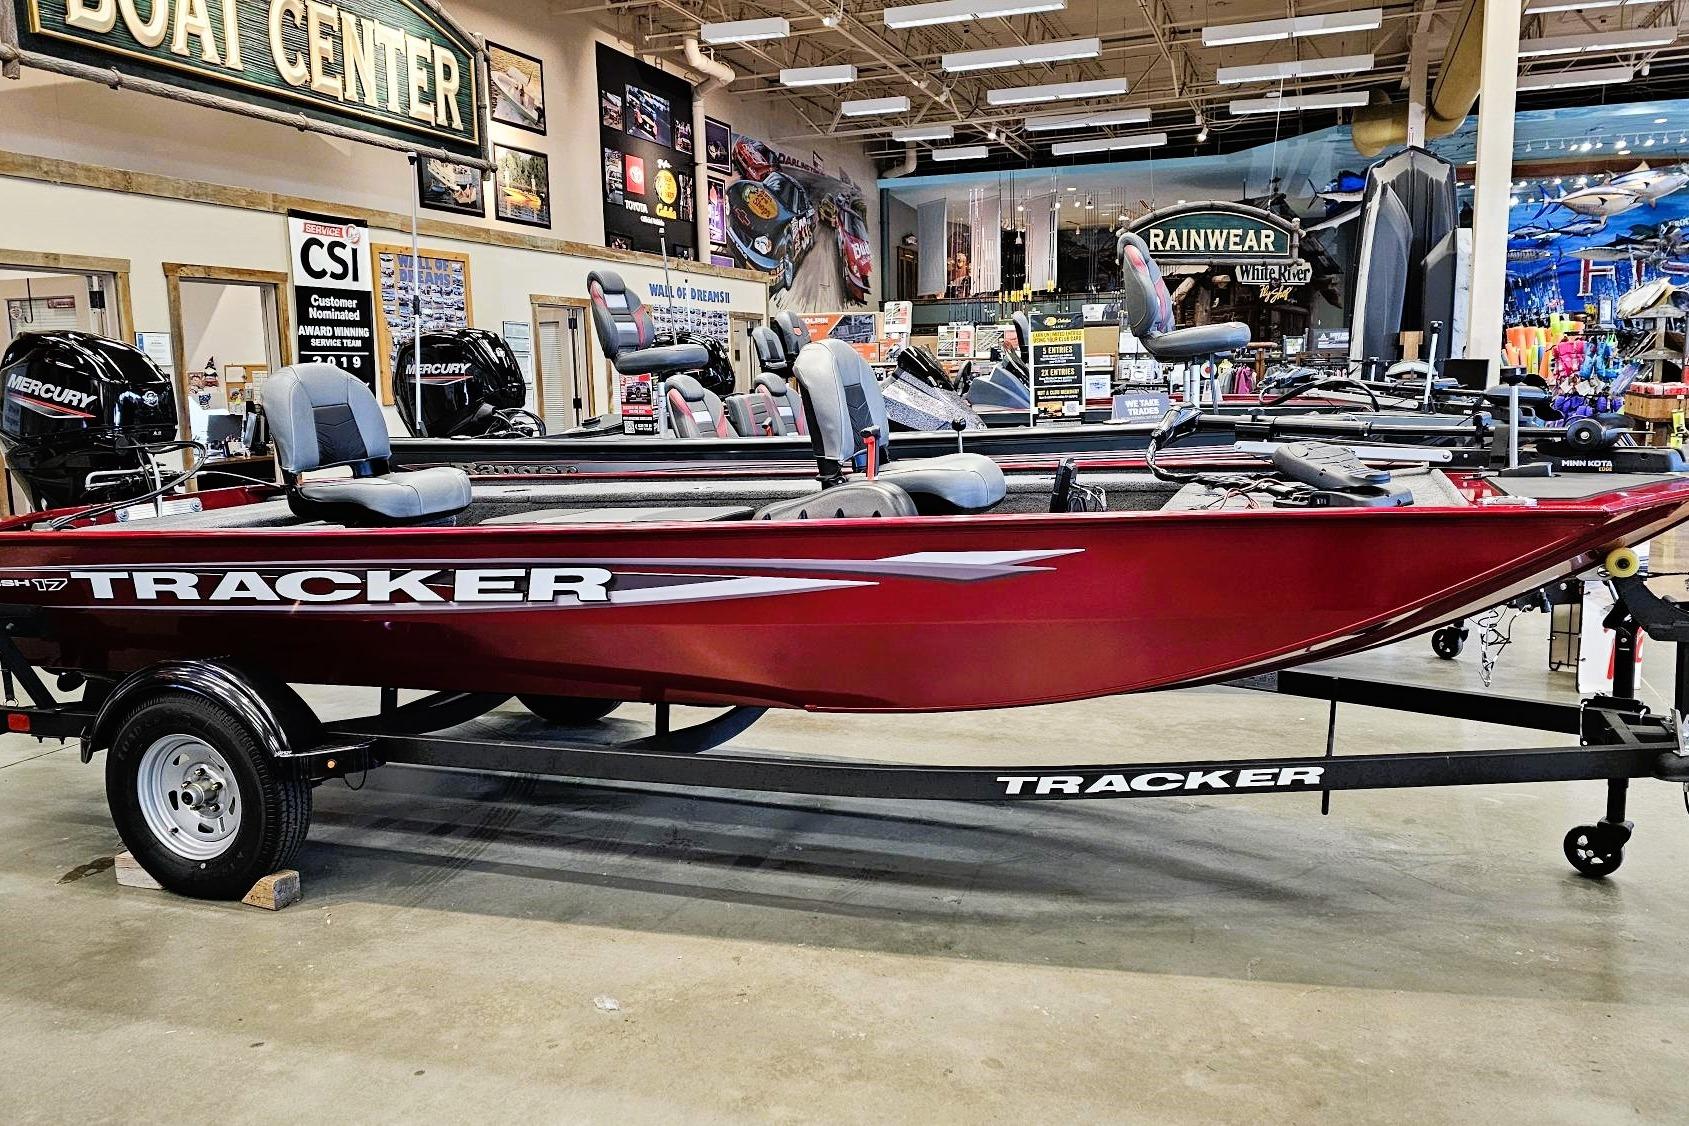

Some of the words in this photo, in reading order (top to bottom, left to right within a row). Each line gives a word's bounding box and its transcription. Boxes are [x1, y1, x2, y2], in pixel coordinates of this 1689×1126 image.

[269, 0, 464, 131] CENTER
[625, 200, 648, 213] TOYOTA
[305, 223, 342, 236] SERVICE
[1149, 228, 1275, 251] RAINWEAR
[1240, 263, 1276, 282] White
[1277, 264, 1310, 282] River
[649, 283, 674, 298] WALL
[676, 286, 687, 299] OF
[310, 294, 358, 308] Customer
[308, 307, 360, 320] Nominated
[298, 325, 333, 336] AWARD
[333, 326, 370, 338] WINNING
[310, 338, 342, 347] SERVICE
[342, 338, 362, 347] TEAM
[1048, 345, 1073, 354] ENTRIES
[405, 363, 472, 375] MERCURY
[1041, 368, 1049, 377] 2X
[1050, 367, 1075, 376] ENTRIES
[7, 373, 98, 409] MERCURY
[1125, 400, 1139, 408] WE
[1140, 399, 1160, 407] TAKE
[1127, 407, 1160, 416] TRADES
[1561, 459, 1586, 467] MINN
[0, 579, 30, 587] SH
[31, 578, 68, 591] 17
[70, 568, 613, 601] TRACKER
[997, 767, 1325, 795] TRACKER
